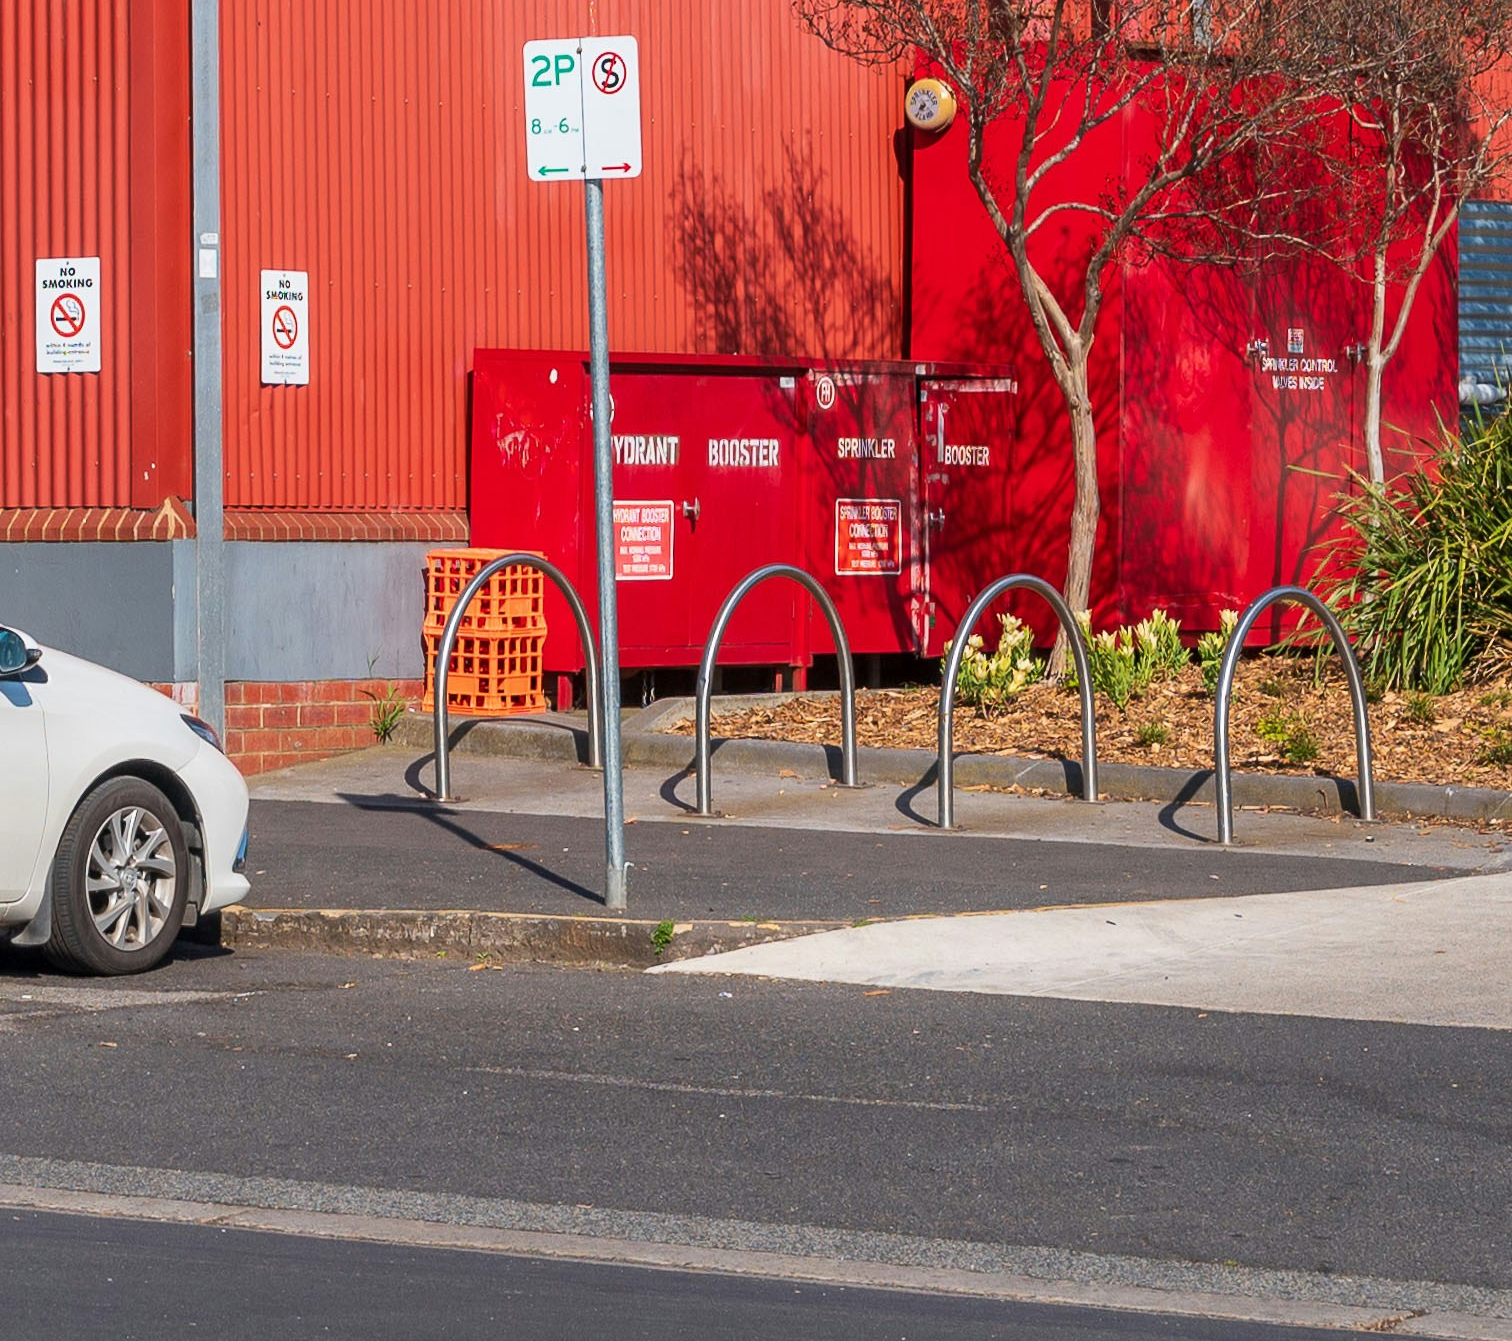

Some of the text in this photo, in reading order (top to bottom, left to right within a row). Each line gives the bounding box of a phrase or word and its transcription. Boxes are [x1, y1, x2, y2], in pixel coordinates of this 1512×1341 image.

[531, 54, 575, 87] 2P
[60, 268, 76, 276] NO
[42, 278, 93, 288] SMOKING
[278, 279, 291, 289] NO
[266, 290, 303, 301] SMOKING
[1300, 358, 1338, 373] CONTROL
[1299, 376, 1324, 390] INSIDE
[611, 435, 779, 466] YDRANT BOOSTER
[838, 438, 990, 466] SPRINKLER BOOSTER
